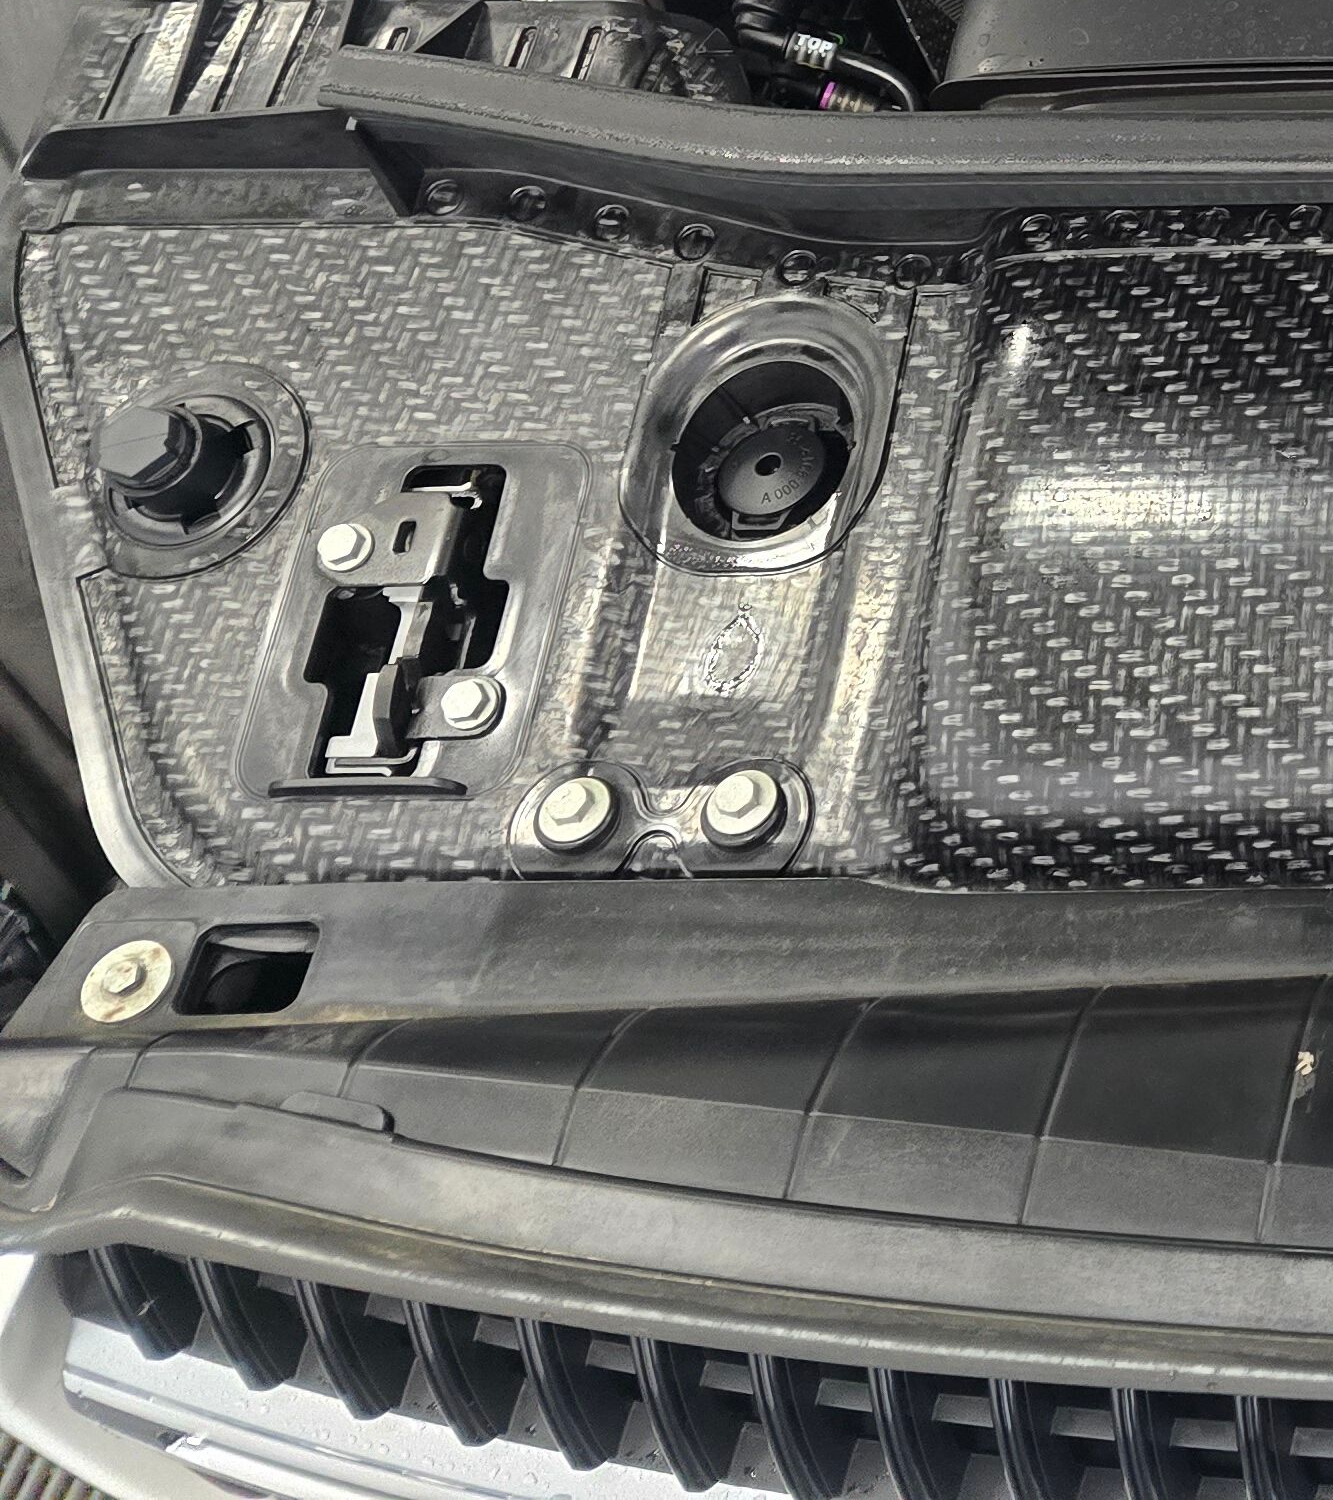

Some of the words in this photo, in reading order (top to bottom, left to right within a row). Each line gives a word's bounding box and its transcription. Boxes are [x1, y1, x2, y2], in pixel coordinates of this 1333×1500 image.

[797, 33, 833, 53] TOP
[761, 492, 772, 504] A
[774, 479, 800, 500] 000
